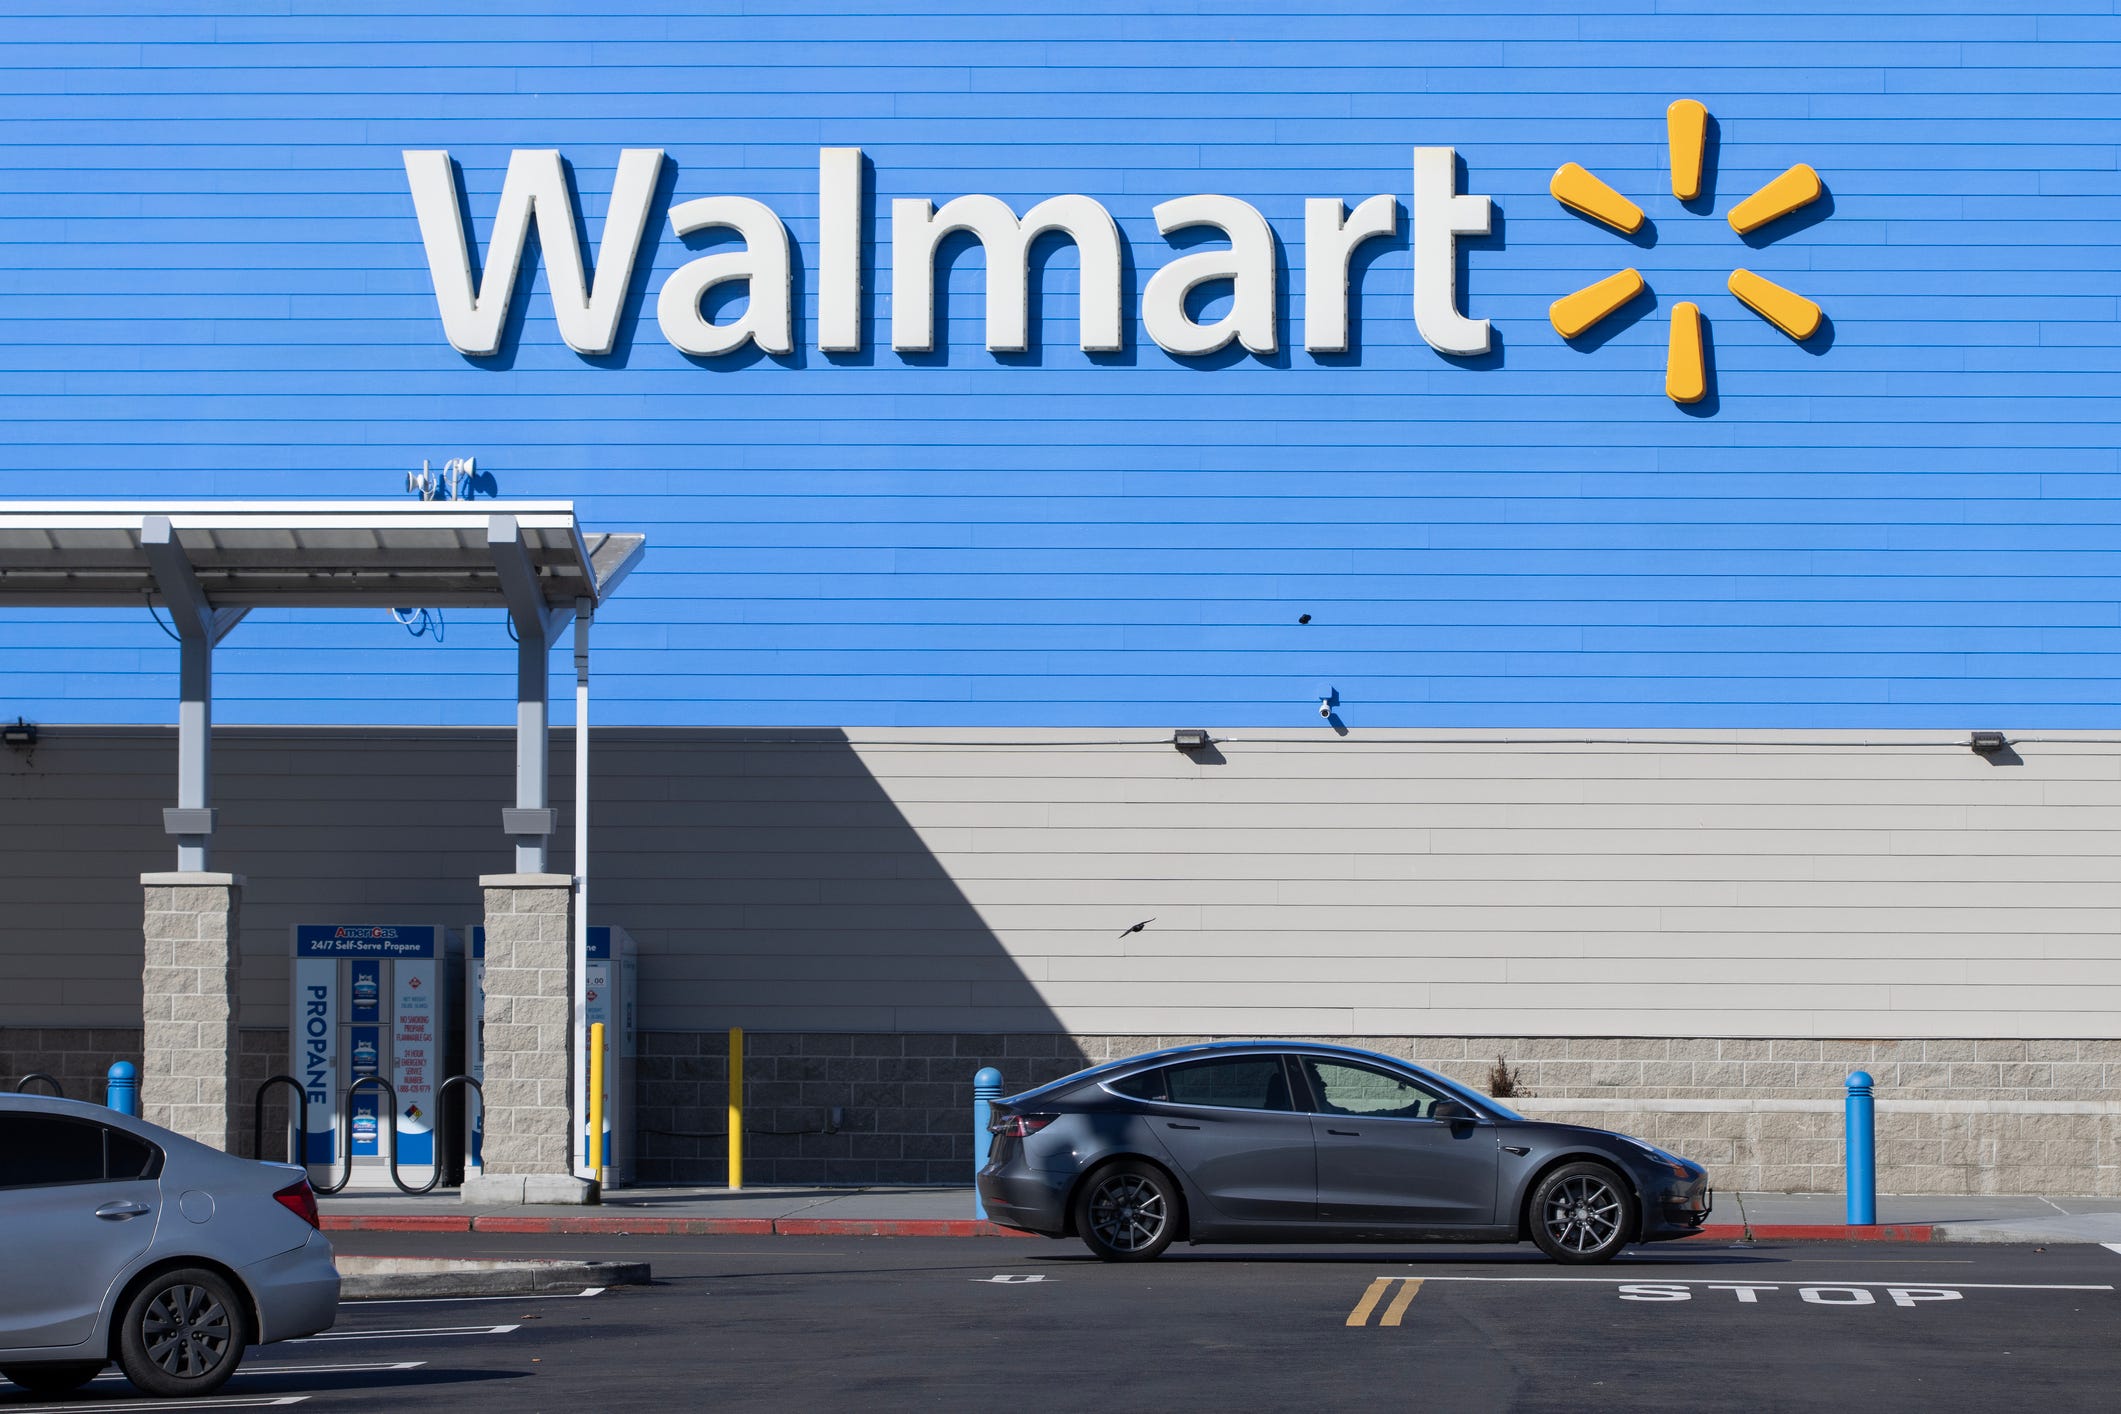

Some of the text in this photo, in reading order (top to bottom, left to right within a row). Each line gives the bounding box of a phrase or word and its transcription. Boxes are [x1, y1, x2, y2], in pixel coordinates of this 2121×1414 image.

[402, 146, 1492, 356] Walmart
[335, 927, 398, 939] AmeriGas
[311, 941, 421, 953] 24/7 Self-Serve Propane
[307, 986, 328, 1105] PROPANE
[1618, 1284, 1963, 1307] STOP
